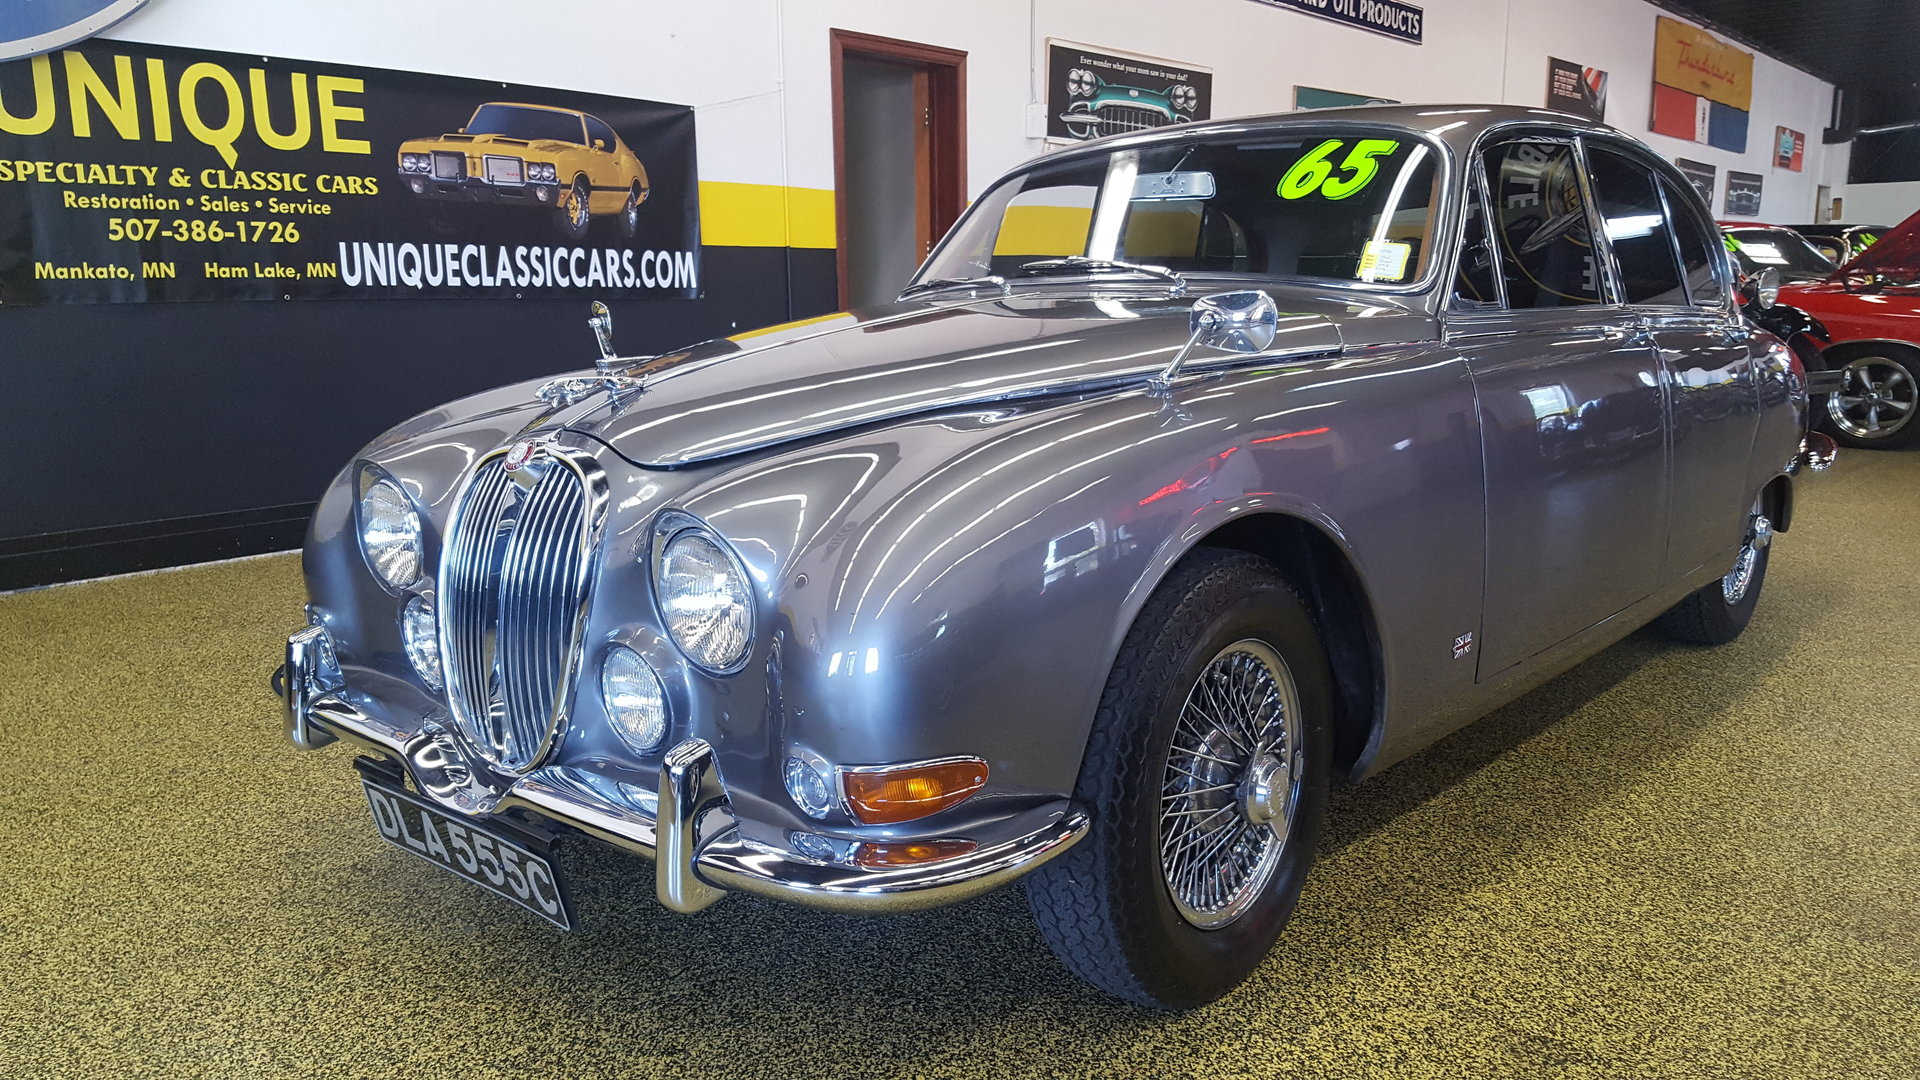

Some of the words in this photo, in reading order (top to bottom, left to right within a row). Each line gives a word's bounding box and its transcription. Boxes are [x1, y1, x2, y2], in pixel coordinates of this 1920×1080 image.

[1333, 0, 1356, 17] OIL
[1359, 1, 1420, 35] PRODUCTS
[1080, 56, 1092, 65] Ever
[1093, 59, 1112, 69] wonder
[1113, 62, 1125, 71] what
[1125, 66, 1137, 74] your
[1150, 69, 1160, 77] saw
[1160, 69, 1165, 77] in
[1166, 72, 1176, 80] your
[0, 50, 371, 169] UNIQUE
[0, 160, 158, 187] SPECIALTY
[168, 167, 191, 188] &
[200, 169, 307, 193] CLASSIC
[316, 173, 379, 195] CARS
[1276, 139, 1399, 200] 65
[63, 190, 180, 211] Restoration
[200, 196, 250, 213] Sales
[269, 197, 332, 215] Service
[108, 218, 300, 243] 507-386-1726
[34, 262, 135, 282] Mankato,
[142, 262, 176, 279] MN
[204, 262, 249, 279] Ham
[254, 262, 301, 281] Lake,
[306, 262, 337, 279] MN
[339, 242, 697, 290] UNIQUECLASSICCARS.COM
